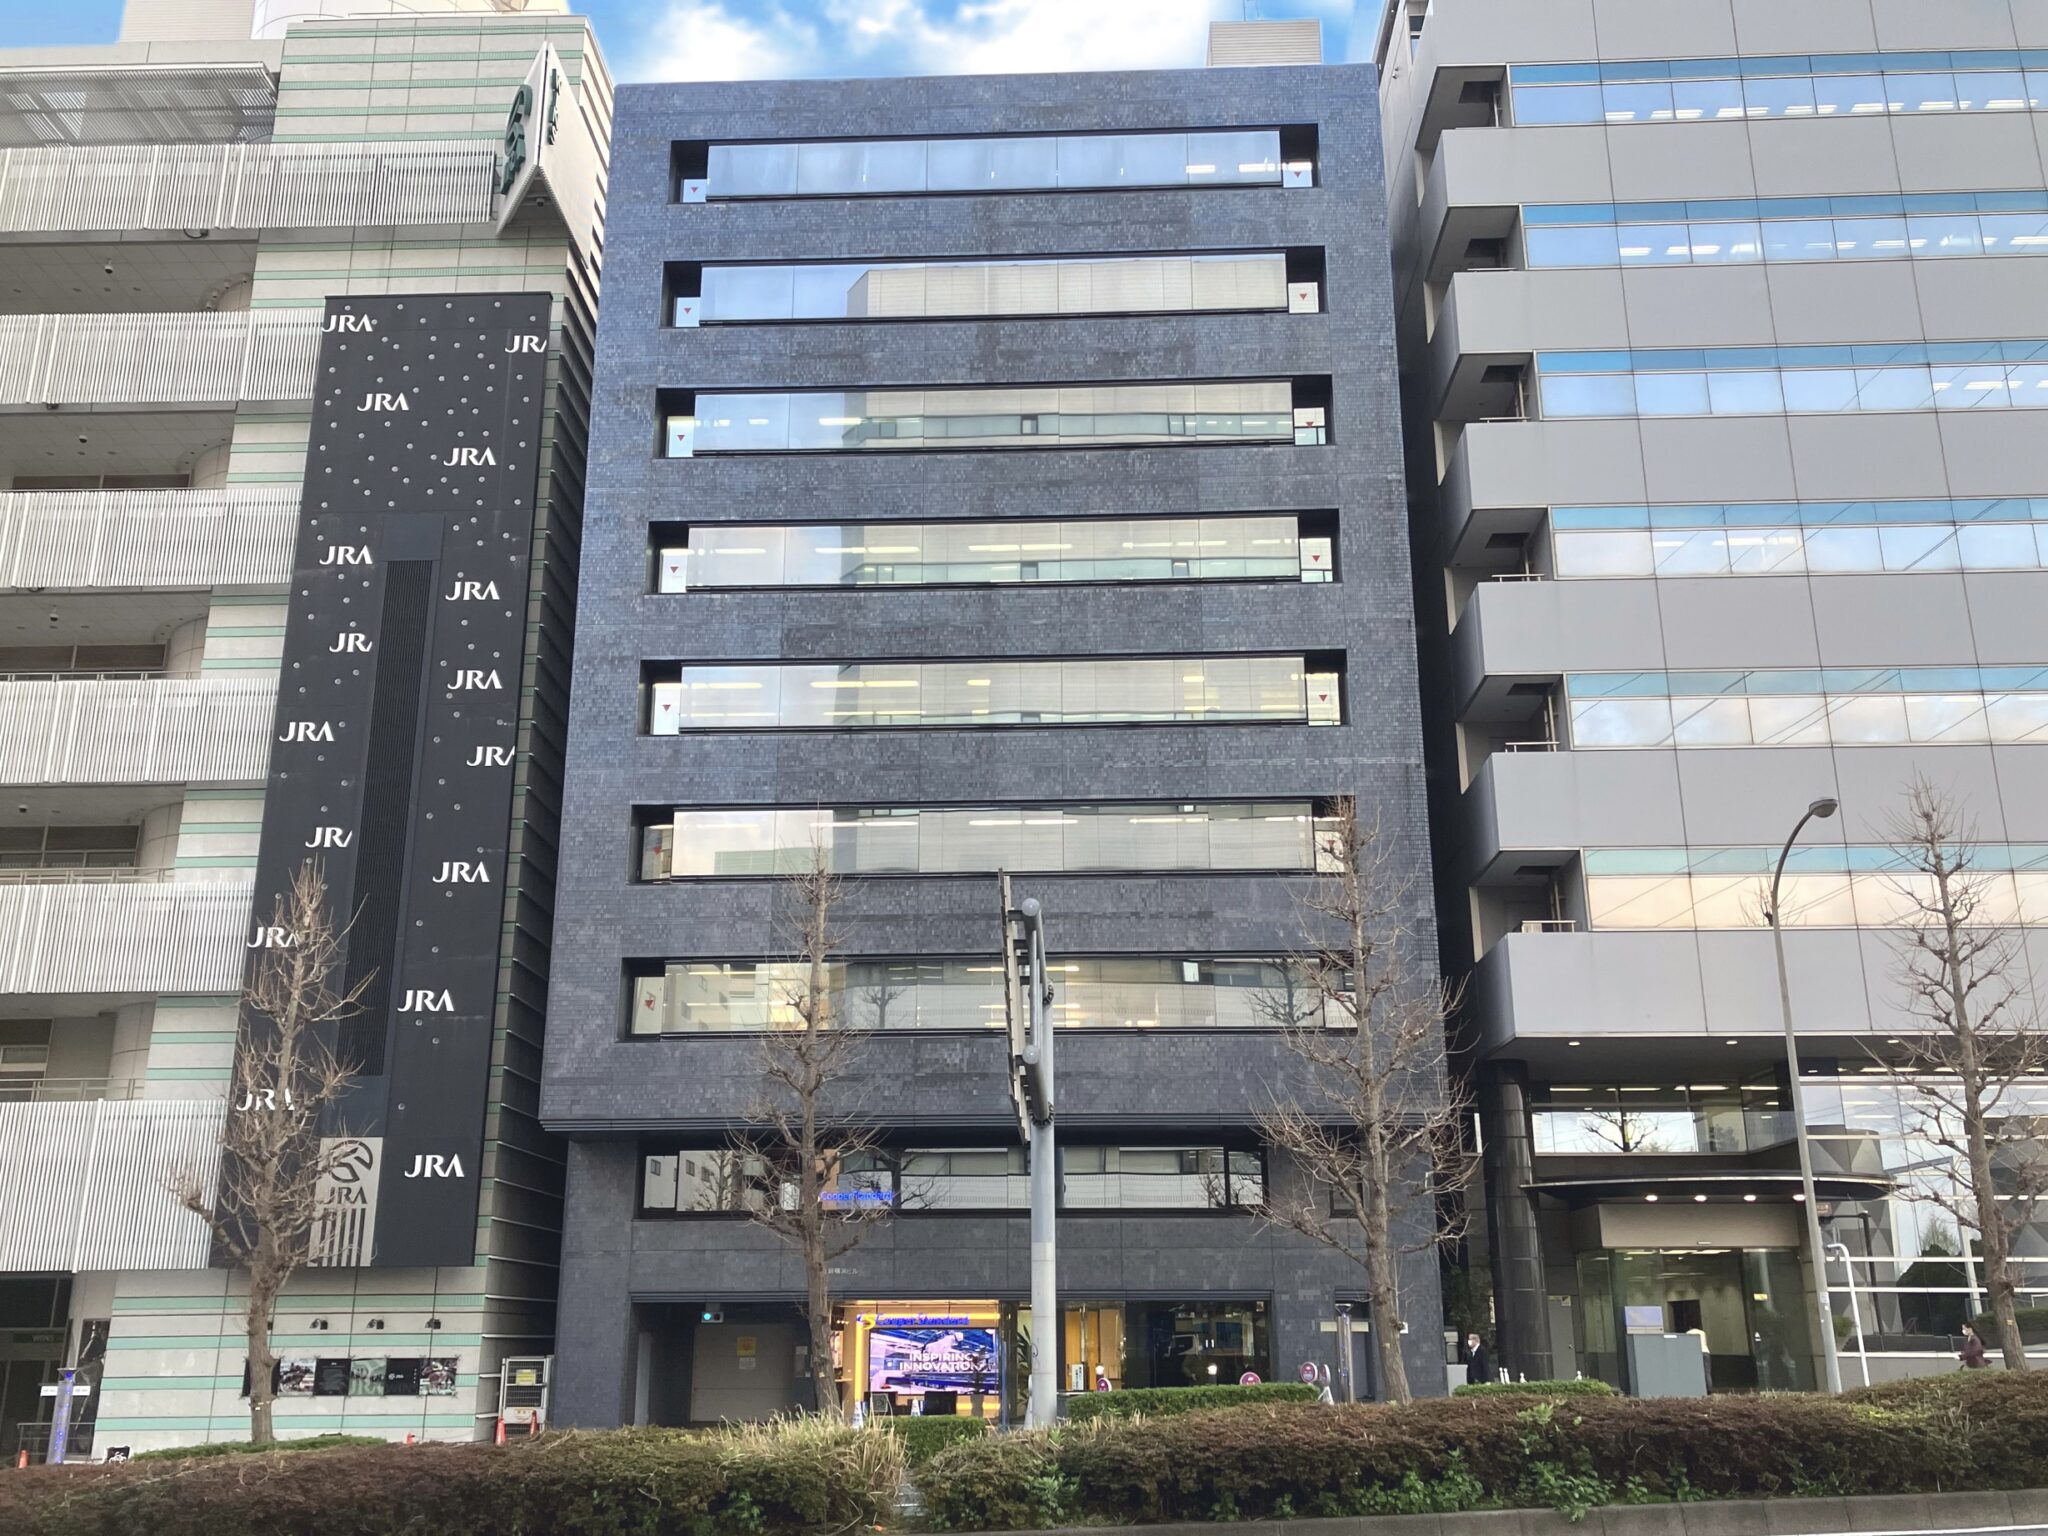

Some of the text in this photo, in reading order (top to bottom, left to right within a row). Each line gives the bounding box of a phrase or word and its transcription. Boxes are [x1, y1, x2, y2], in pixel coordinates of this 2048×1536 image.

[321, 314, 373, 332] JRA
[356, 392, 410, 412] JRA
[443, 446, 497, 467] JRA
[319, 545, 374, 565] JRA
[445, 580, 500, 601] JRA
[447, 669, 503, 690] JRA
[278, 721, 335, 742] JRA
[432, 861, 490, 883] JRA
[397, 988, 455, 1012] JRA
[404, 1153, 465, 1178] JRA
